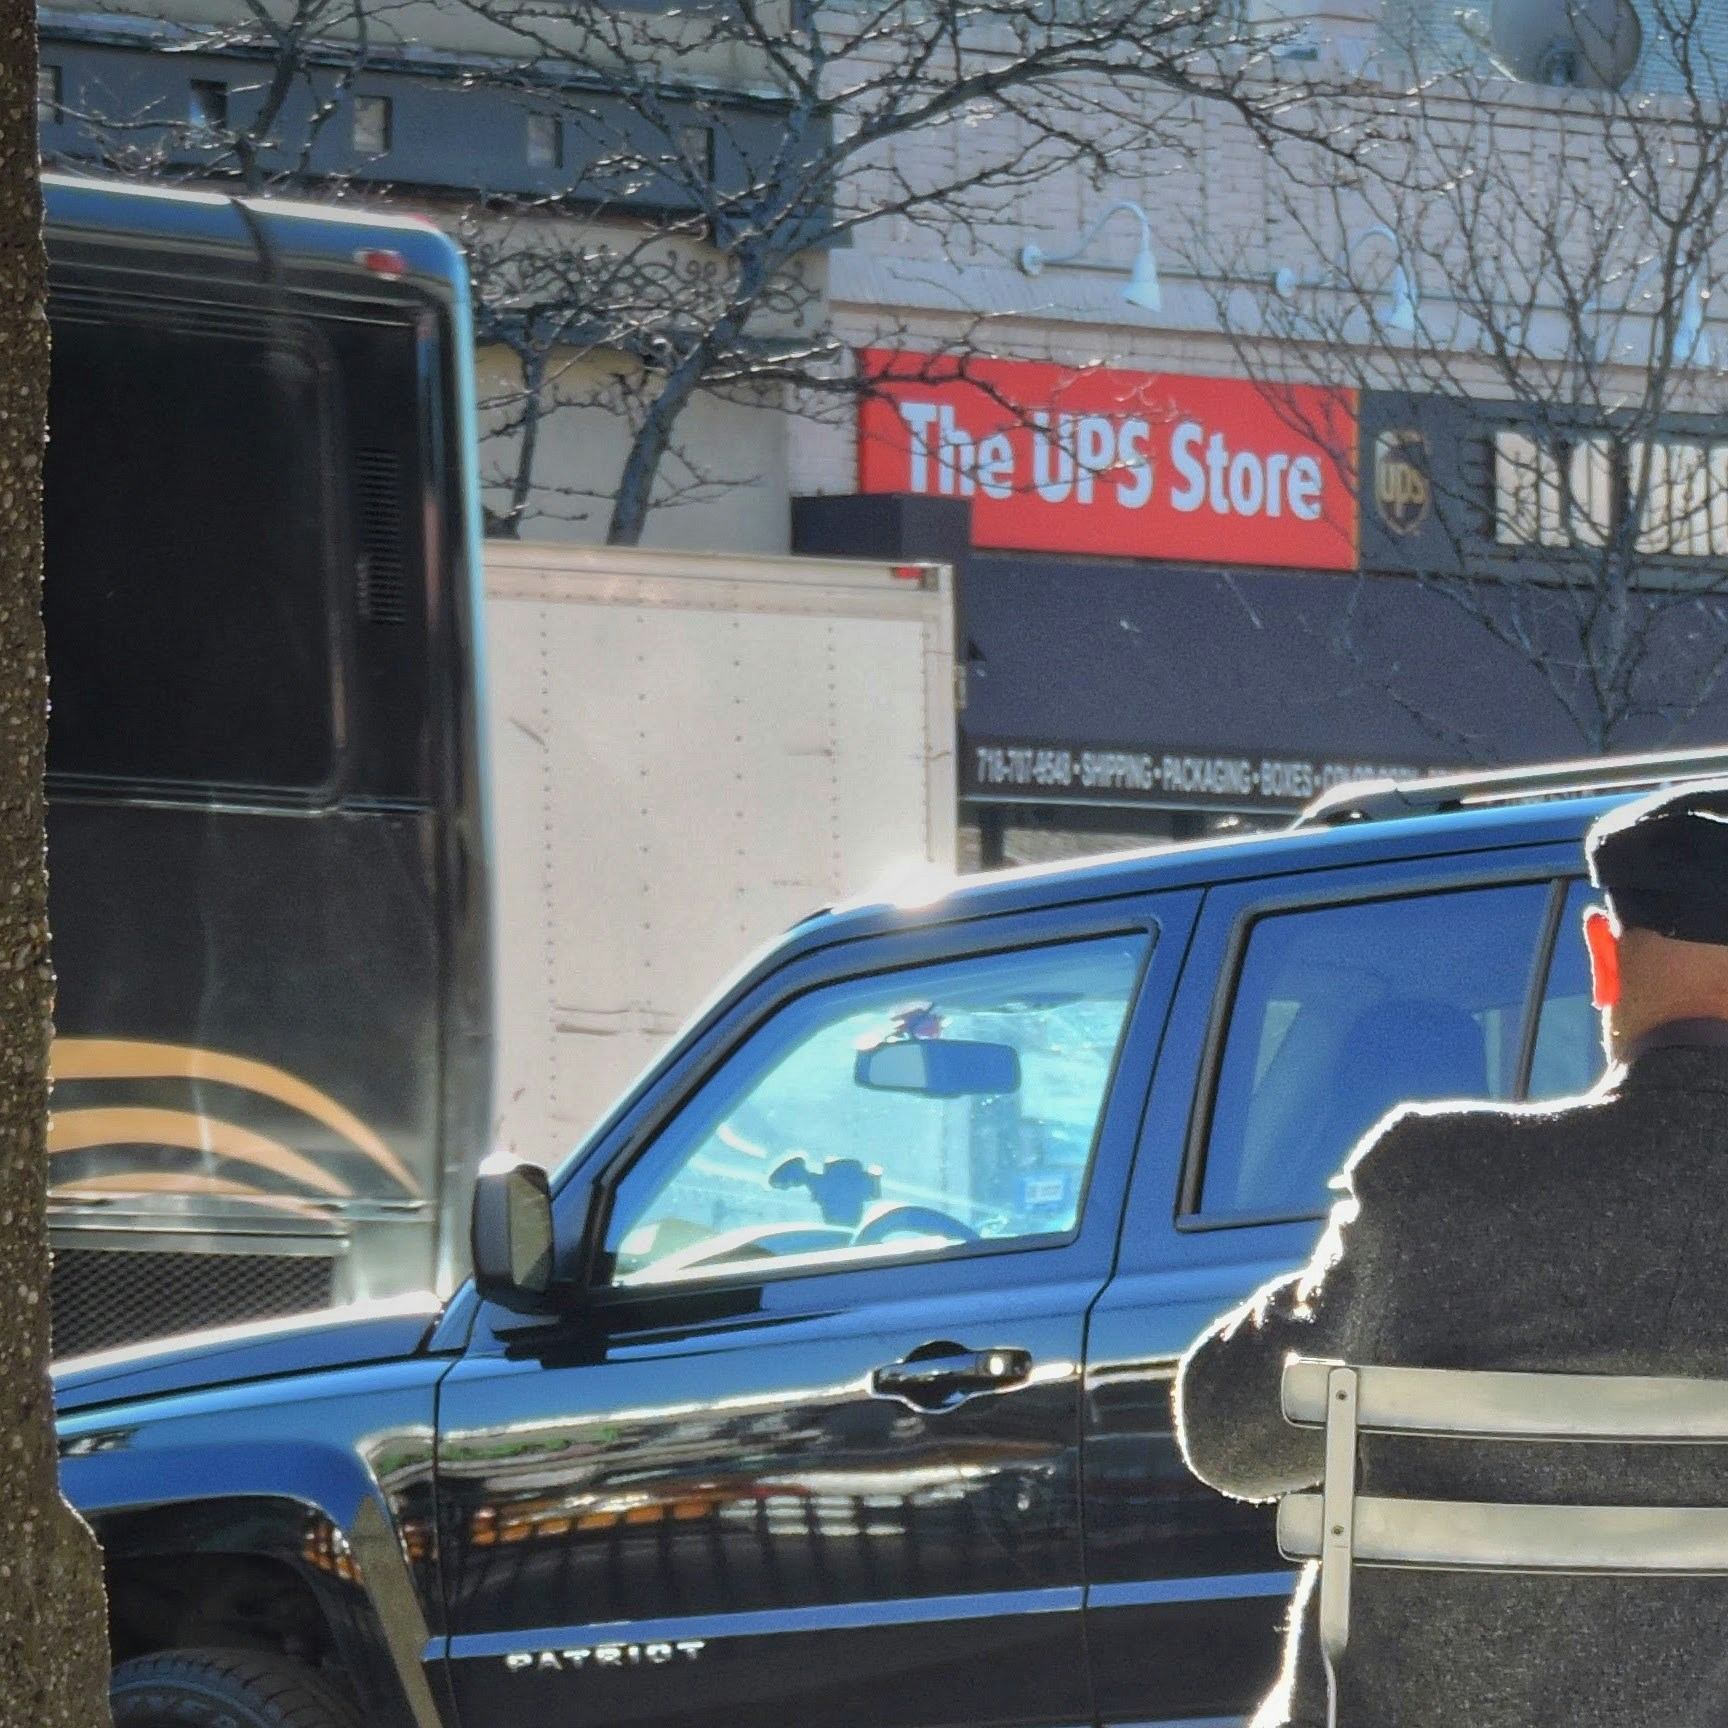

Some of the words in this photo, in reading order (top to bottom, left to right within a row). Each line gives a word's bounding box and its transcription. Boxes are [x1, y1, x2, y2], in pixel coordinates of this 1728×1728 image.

[900, 401, 1013, 500] The
[1033, 409, 1153, 509] UPS
[1170, 422, 1322, 520] Store
[1081, 750, 1152, 791] SHIPPING
[1162, 755, 1250, 794] PACKAGING
[1261, 758, 1313, 797] BOXES
[505, 1641, 705, 1673] PATRIOT
